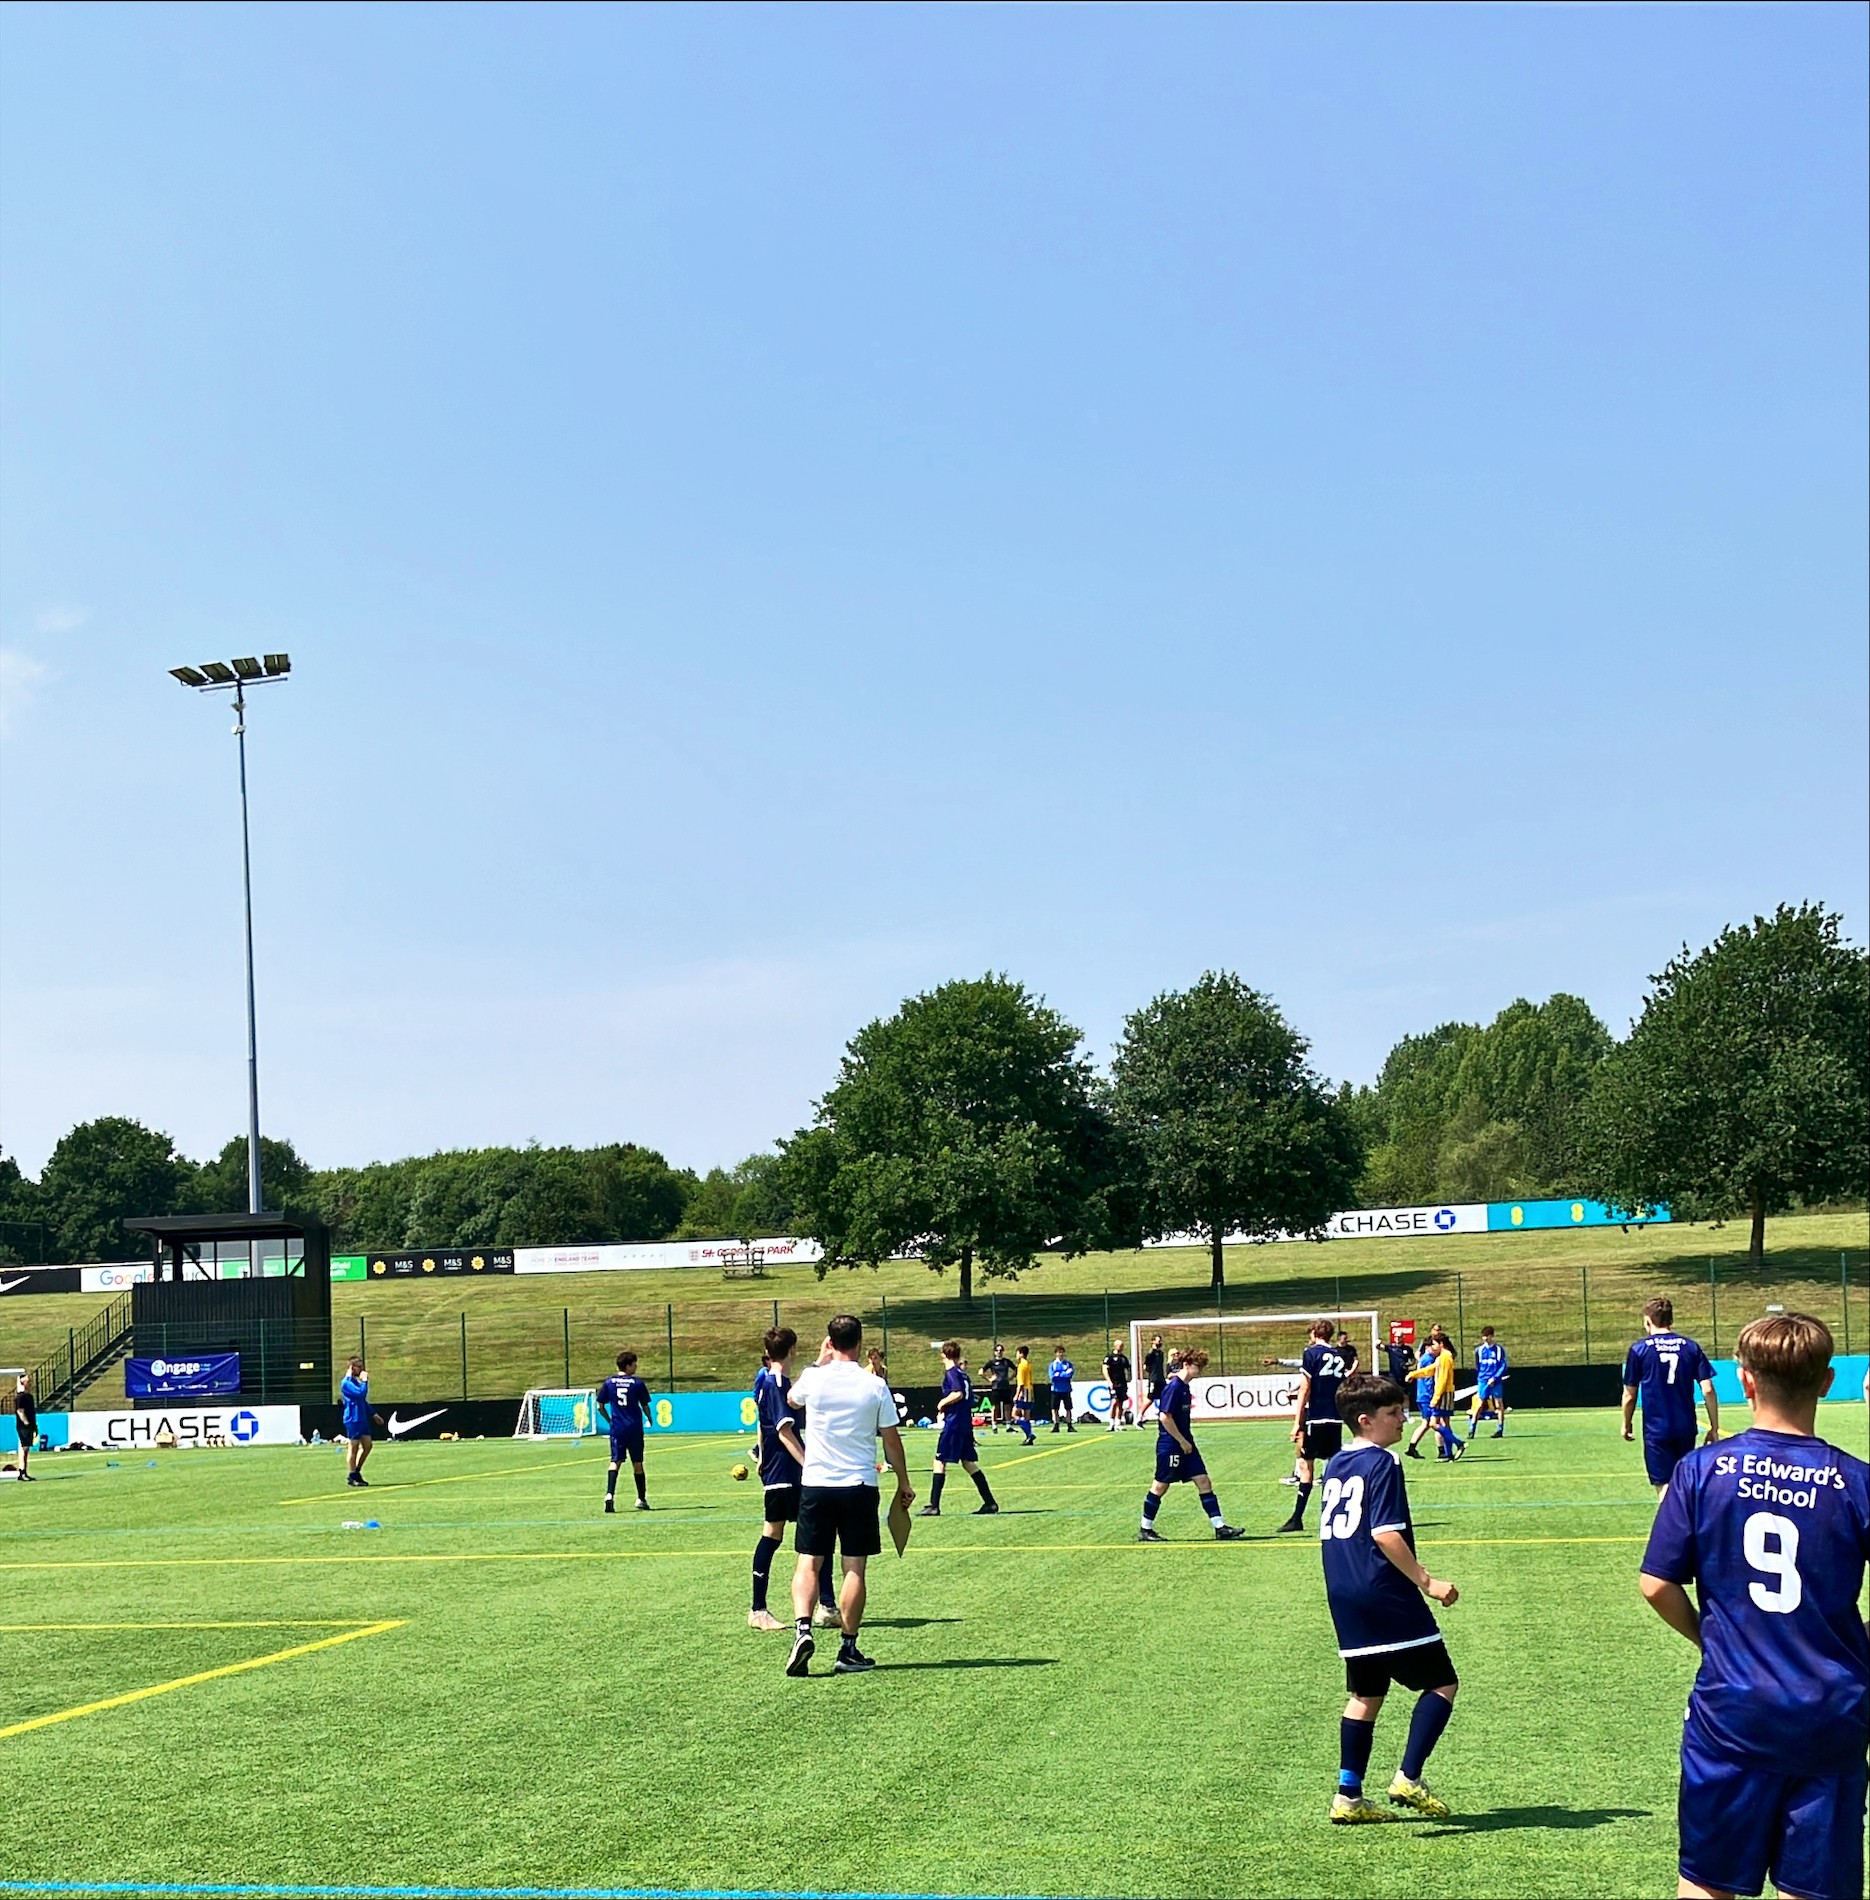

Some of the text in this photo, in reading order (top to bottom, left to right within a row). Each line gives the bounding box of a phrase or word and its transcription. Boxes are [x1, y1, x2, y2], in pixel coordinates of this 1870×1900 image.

[1340, 1213, 1428, 1232] CHASE
[493, 1256, 512, 1265] M&S
[767, 1245, 794, 1255] PARK
[395, 1260, 414, 1269] M&S
[443, 1258, 462, 1267] M&S
[100, 1264, 155, 1286] Google
[1319, 1352, 1345, 1378] 22
[1659, 1352, 1679, 1384] 7
[616, 1387, 629, 1406] 5
[1205, 1382, 1293, 1409] Cloud
[108, 1415, 223, 1442] CHASE
[1169, 1455, 1180, 1468] 15
[1715, 1454, 1846, 1490] St Edward's
[1737, 1477, 1817, 1509] School
[1320, 1475, 1365, 1540] 23
[1743, 1511, 1802, 1614] 9
